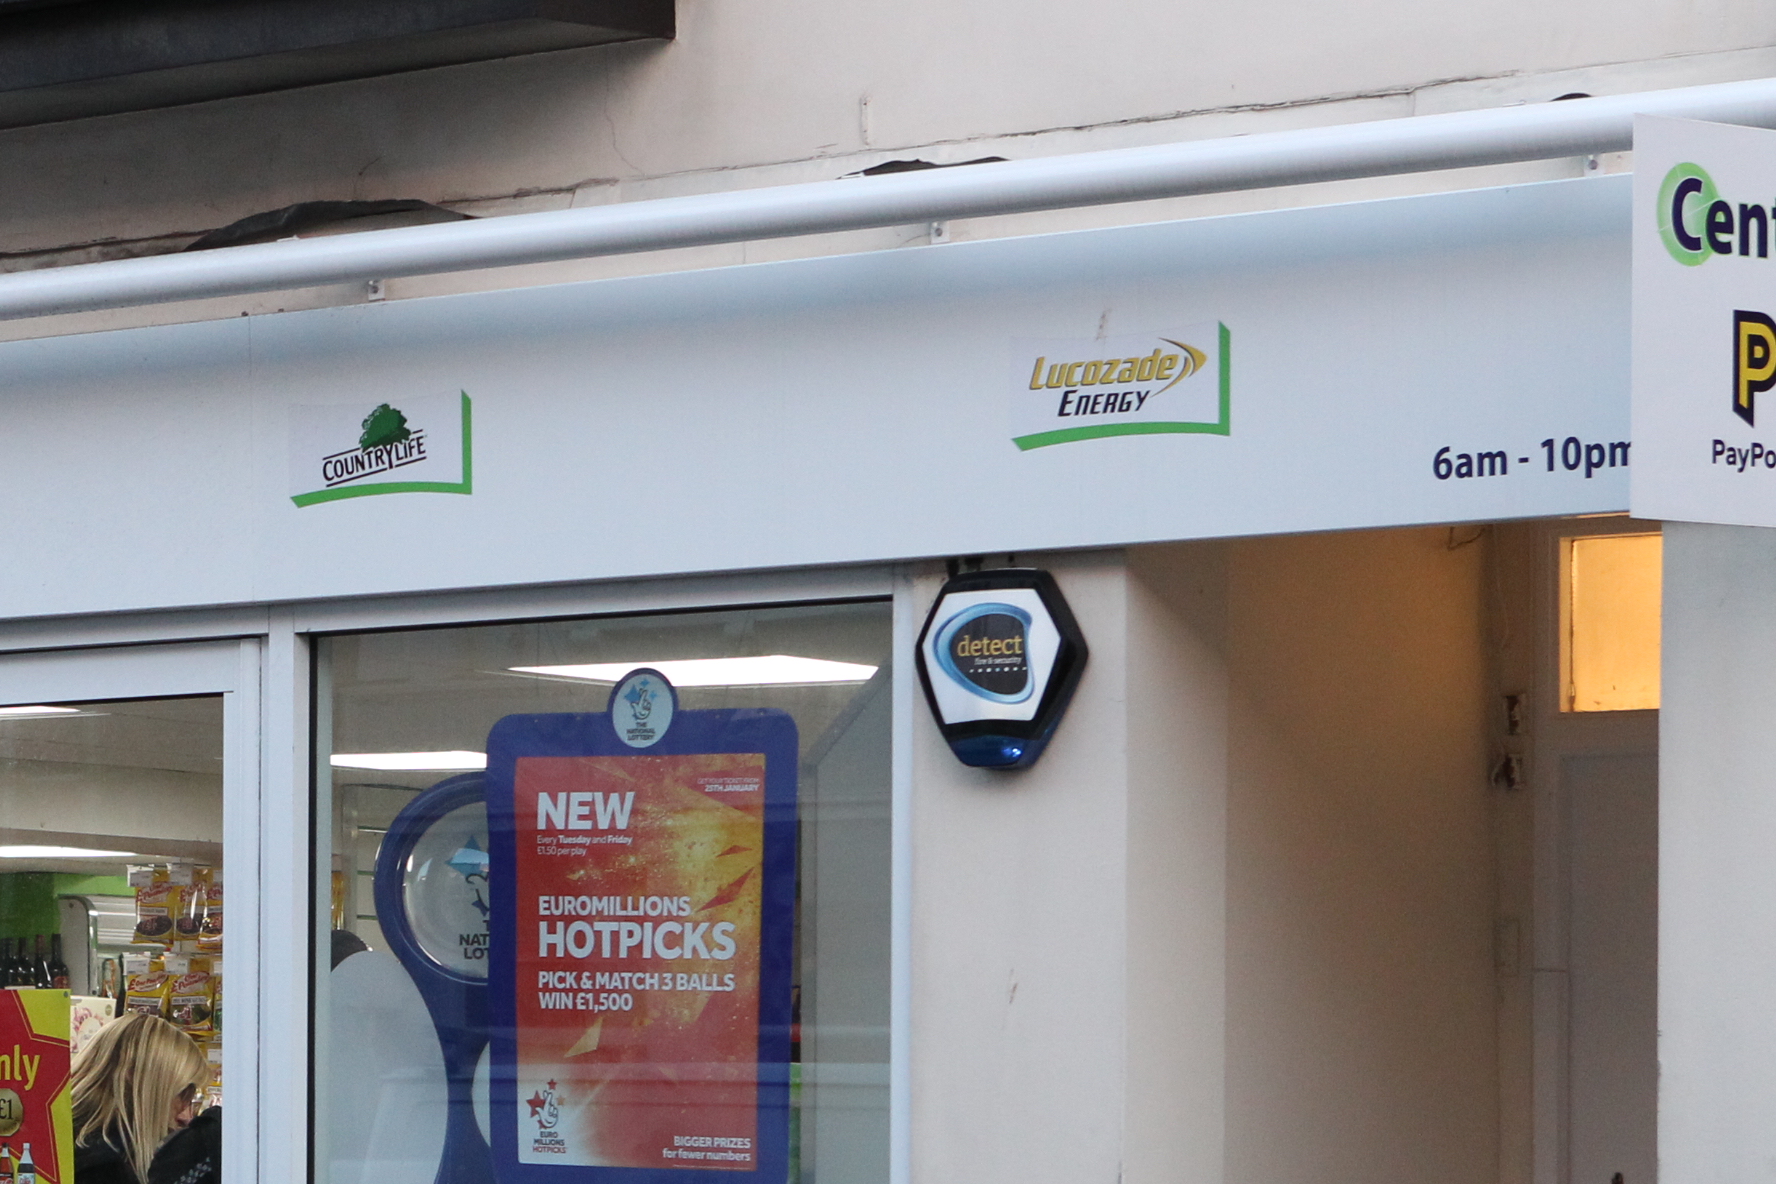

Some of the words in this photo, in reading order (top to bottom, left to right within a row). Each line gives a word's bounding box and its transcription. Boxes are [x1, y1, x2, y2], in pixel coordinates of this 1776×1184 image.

[1029, 348, 1180, 391] Lucozade
[1058, 389, 1151, 417] ENERGY
[1432, 446, 1508, 480] 6am
[957, 635, 1023, 657] detect
[723, 784, 760, 792] JANUARY
[536, 791, 635, 830] NEW
[537, 835, 558, 845] Every
[558, 835, 591, 846] Tuesday
[592, 835, 607, 844] and
[607, 835, 633, 846] Friday
[557, 848, 571, 857] per
[571, 846, 587, 857] play
[538, 896, 692, 917] EUROMILLIONS
[538, 920, 737, 960] HOTPICKS
[538, 971, 579, 989] PICK
[580, 971, 593, 990] &
[595, 972, 659, 991] MATCH
[661, 972, 673, 991] 3
[676, 973, 736, 992] BALLS
[539, 992, 573, 1010] WIN
[576, 992, 633, 1013] £1,500
[533, 1138, 565, 1146] MILLIONS
[540, 1131, 559, 1139] EURO
[674, 1136, 712, 1148] BIGGER
[714, 1137, 751, 1149] PRIZES
[532, 1146, 566, 1154] HOTPICKS
[663, 1148, 677, 1159] for
[678, 1149, 706, 1160] fewer
[706, 1150, 751, 1162] numbers
